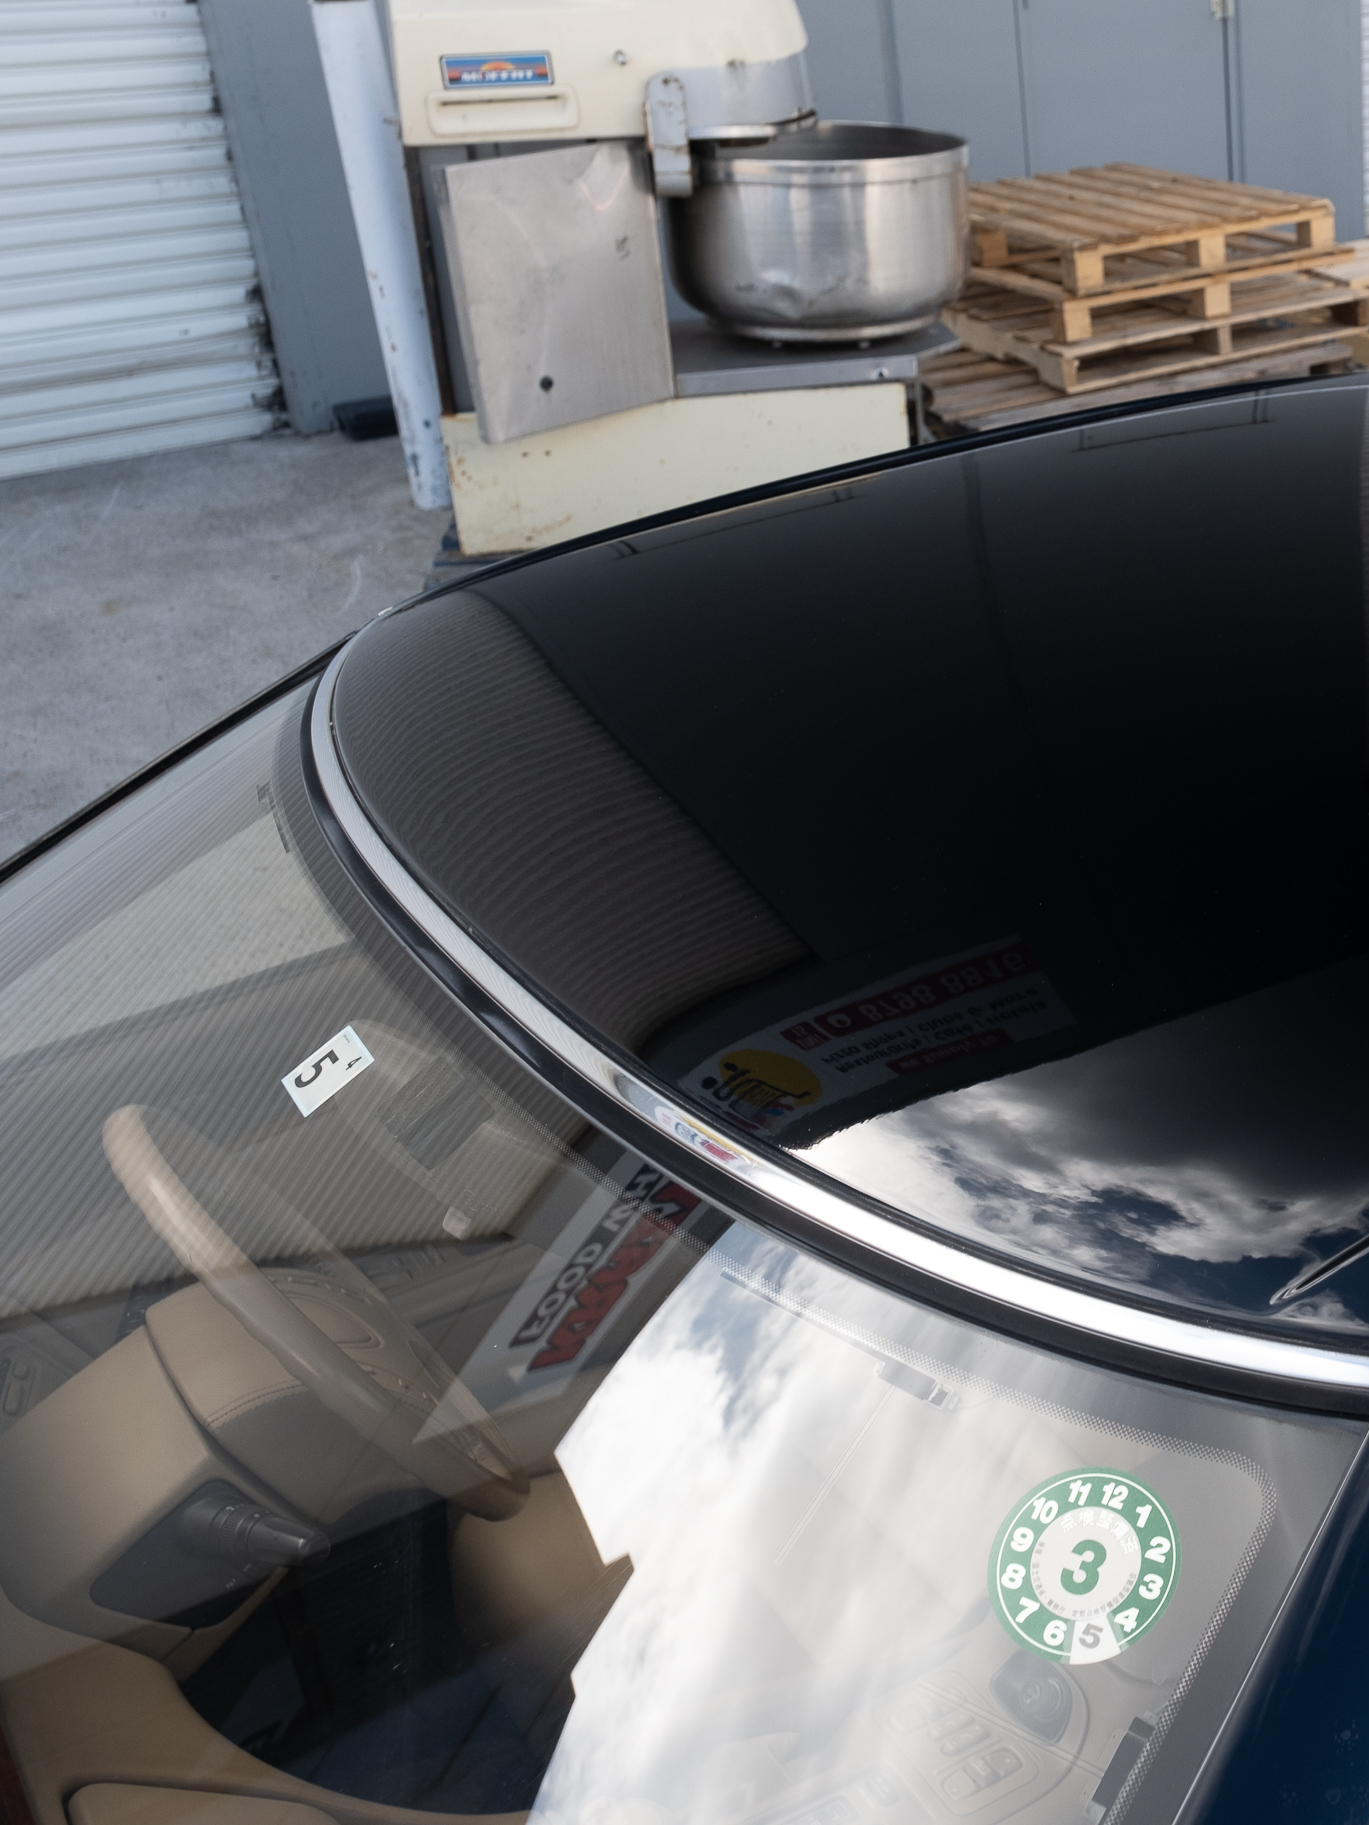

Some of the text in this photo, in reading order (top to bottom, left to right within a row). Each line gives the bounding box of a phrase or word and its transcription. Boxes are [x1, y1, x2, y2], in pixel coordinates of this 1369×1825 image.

[294, 1049, 340, 1089] 5
[1000, 1479, 1171, 1649] 10 11 12 1 2 3 4 5 6 7 8 9
[1060, 1539, 1107, 1596] 3
